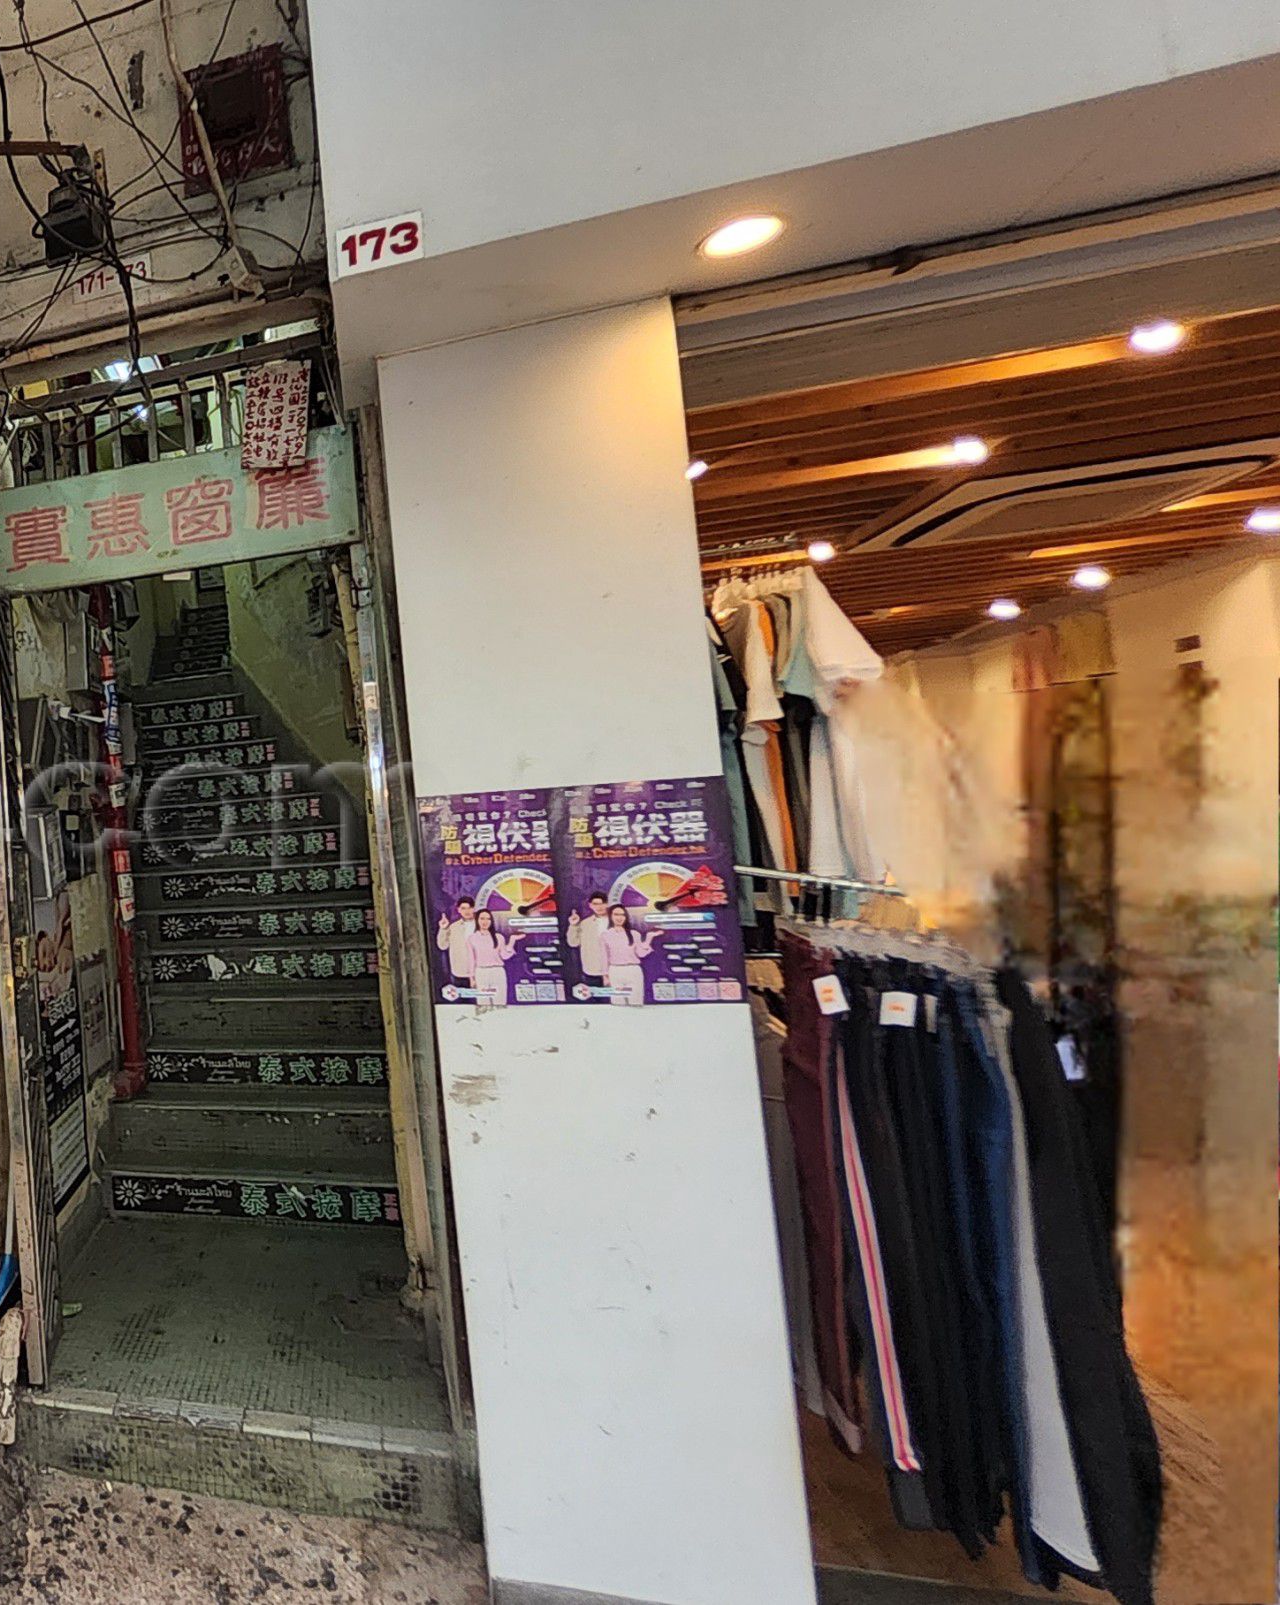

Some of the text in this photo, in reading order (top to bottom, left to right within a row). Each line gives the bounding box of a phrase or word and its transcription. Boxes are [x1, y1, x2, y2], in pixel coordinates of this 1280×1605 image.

[341, 221, 419, 267] 173
[76, 260, 147, 296] 171-73
[4, 456, 332, 573] 實惠窗簾
[256, 866, 356, 895] 泰式按摩
[258, 908, 364, 937] 泰式按摩
[258, 1055, 384, 1084] 泰式按摩
[240, 1183, 383, 1222] 泰式按摩
